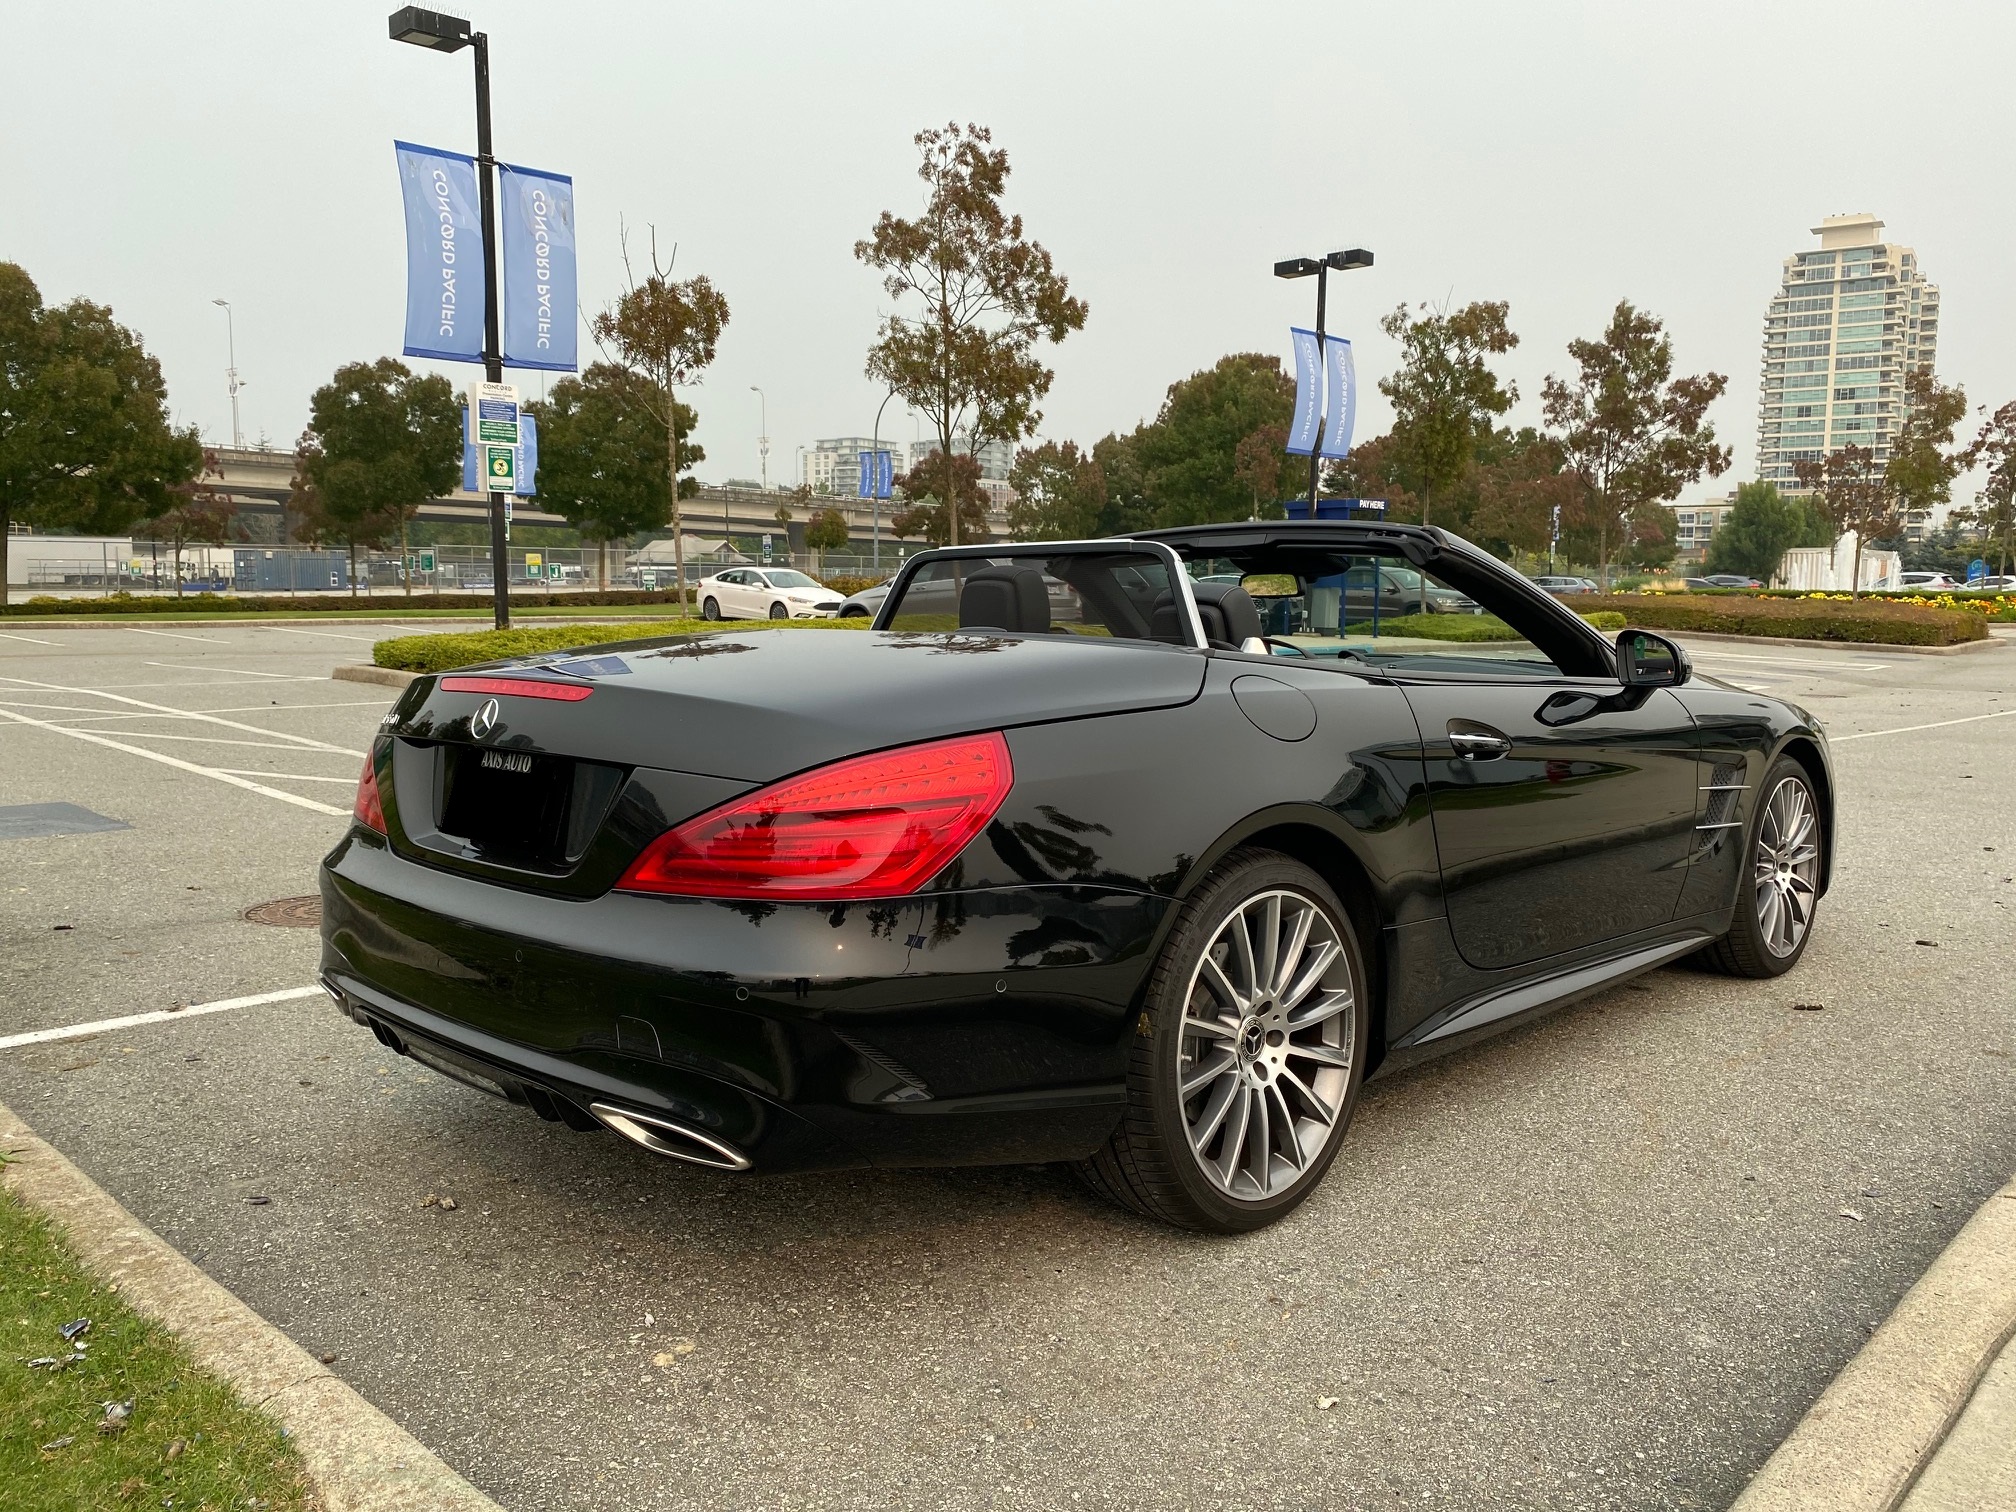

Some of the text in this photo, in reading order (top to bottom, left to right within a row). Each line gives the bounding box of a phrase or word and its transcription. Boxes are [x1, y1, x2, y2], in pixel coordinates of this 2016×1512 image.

[483, 383, 512, 391] CONCORD
[1359, 499, 1385, 510] PAY HERE
[551, 565, 559, 577] J
[481, 751, 532, 774] AXIS AUTO
